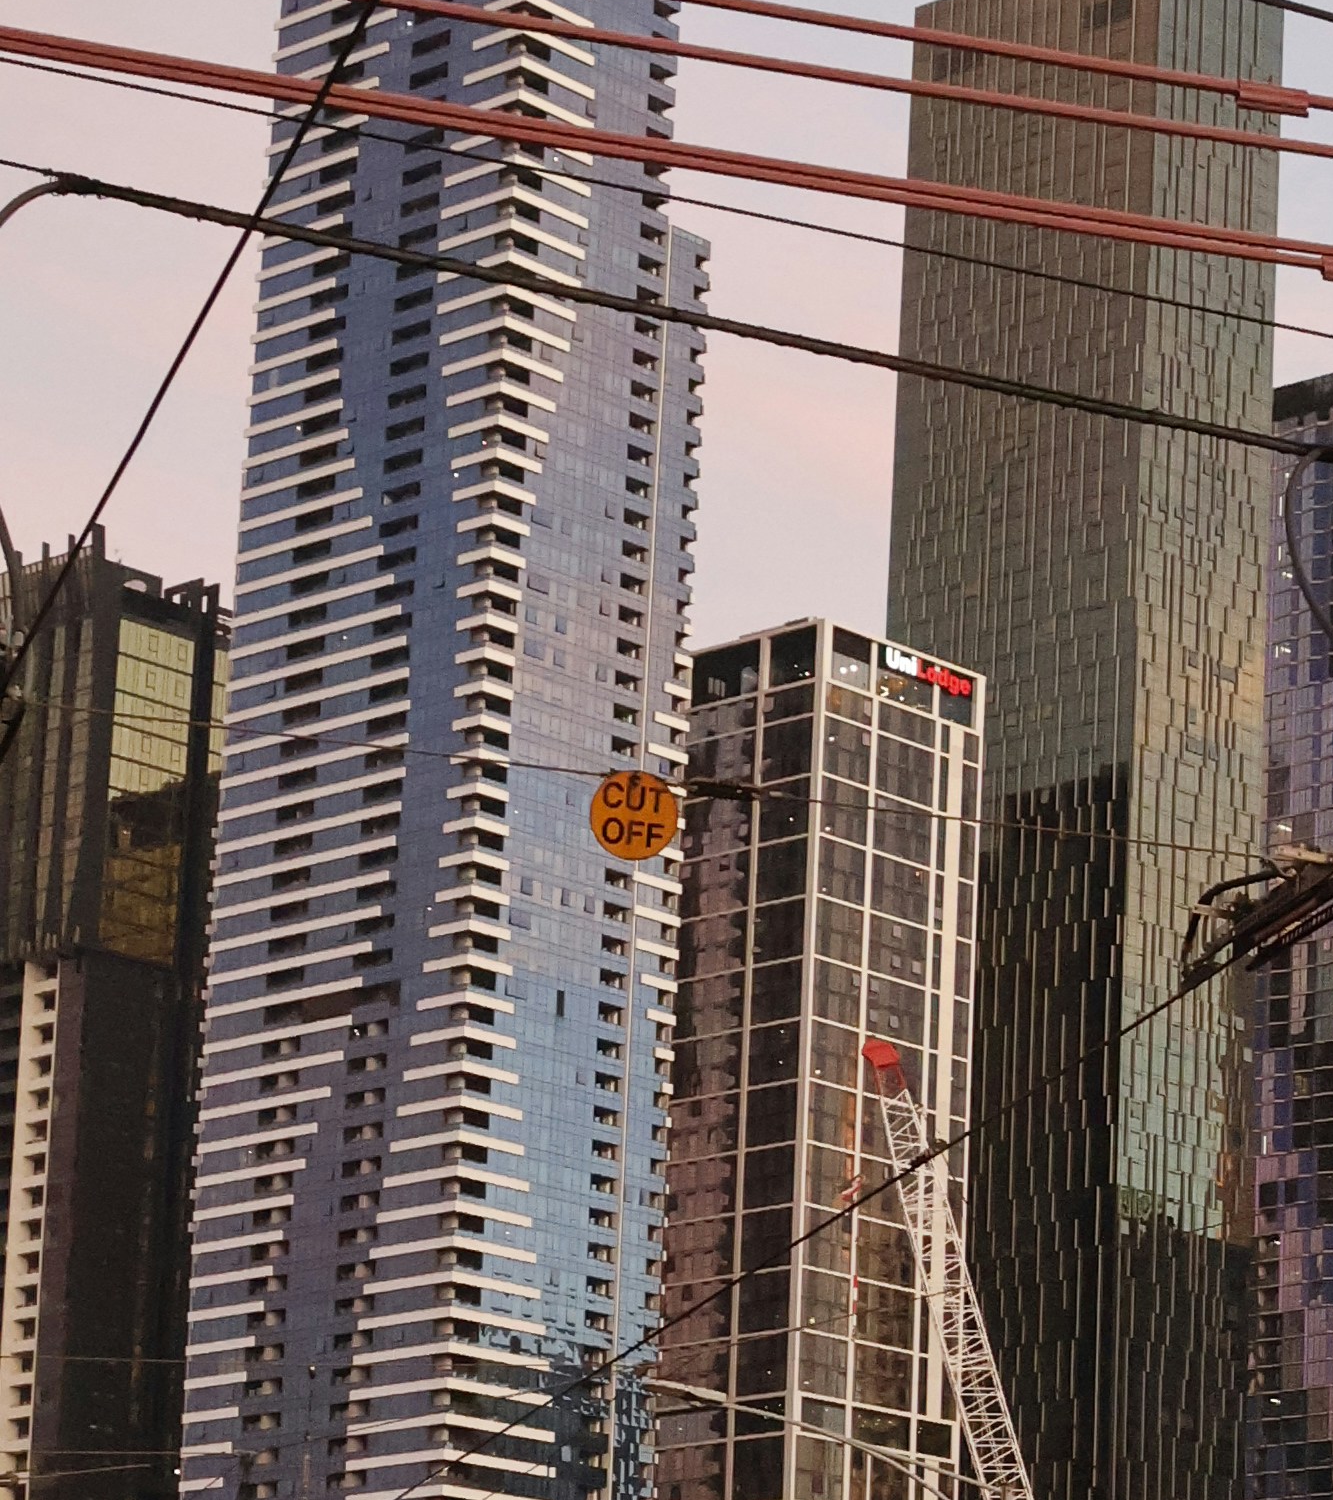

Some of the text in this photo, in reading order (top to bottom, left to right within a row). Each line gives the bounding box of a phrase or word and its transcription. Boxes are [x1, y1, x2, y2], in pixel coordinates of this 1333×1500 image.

[886, 646, 971, 697] UniLodge
[603, 781, 668, 813] CUT
[601, 817, 665, 849] OFF
